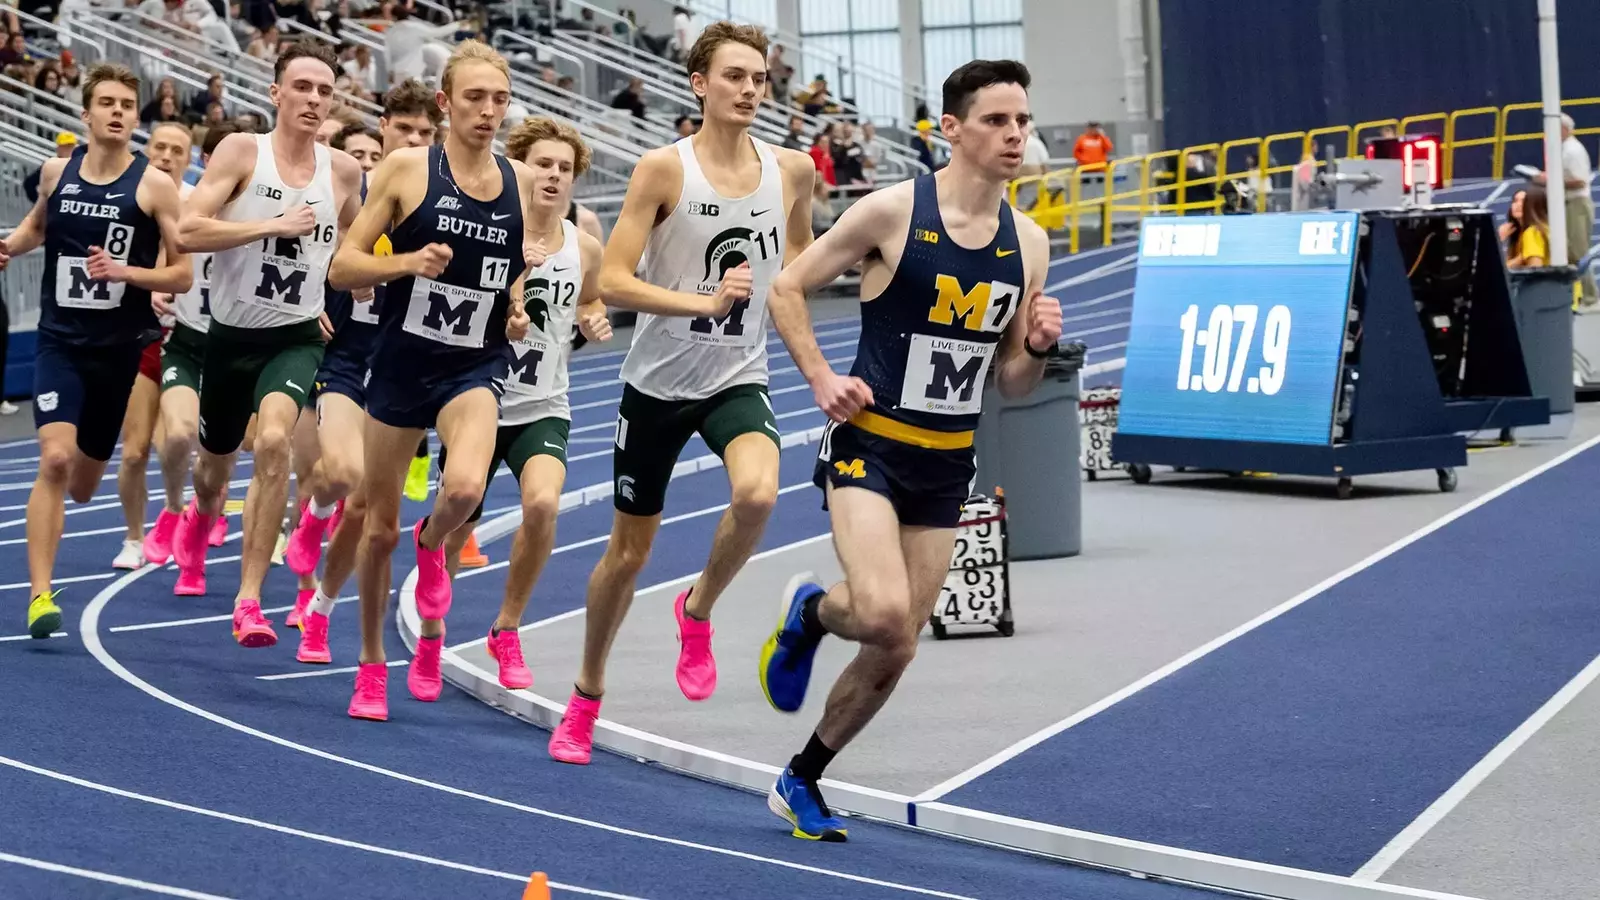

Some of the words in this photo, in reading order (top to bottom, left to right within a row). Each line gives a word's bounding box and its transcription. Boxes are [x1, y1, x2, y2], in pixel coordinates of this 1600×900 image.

[59, 199, 120, 219] BUTLER
[108, 227, 128, 255] 8
[313, 224, 334, 243] 16
[437, 215, 508, 246] BUTLER
[754, 226, 779, 260] 11
[262, 255, 280, 265] LIVE
[282, 260, 310, 271] SPLITS
[486, 261, 508, 282] 17
[68, 266, 110, 300] M
[254, 262, 308, 305] M
[429, 283, 449, 293] LIVE
[452, 288, 482, 300] SPLITS
[552, 280, 575, 307] 12
[697, 283, 718, 292] LIVE
[422, 291, 480, 336] M
[928, 273, 993, 332] M
[992, 293, 1012, 327] 1
[518, 339, 547, 350] SPLITS
[931, 340, 955, 351] LIVE
[957, 343, 989, 354] SPLITS
[1177, 304, 1291, 395] 1:07.9
[924, 350, 984, 402] M
[944, 593, 961, 621] 4
